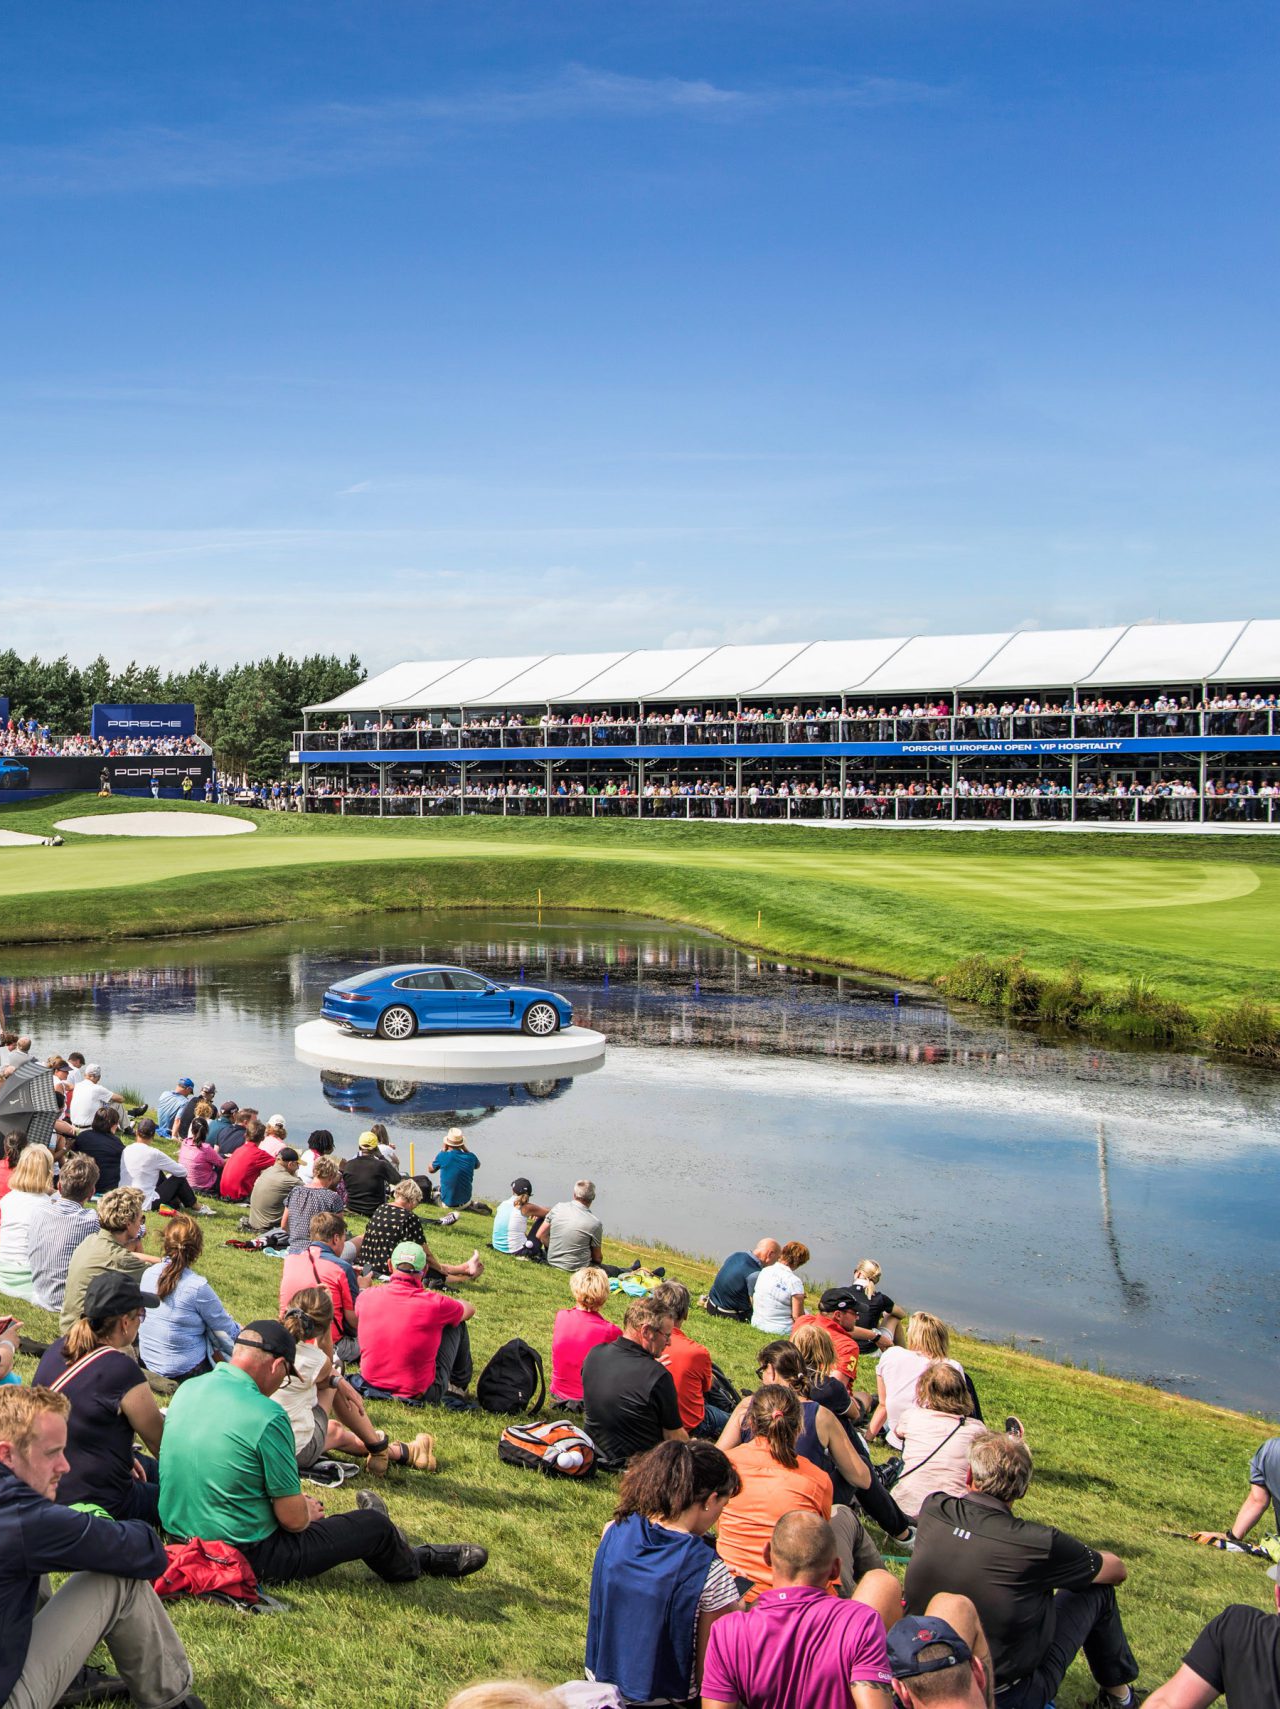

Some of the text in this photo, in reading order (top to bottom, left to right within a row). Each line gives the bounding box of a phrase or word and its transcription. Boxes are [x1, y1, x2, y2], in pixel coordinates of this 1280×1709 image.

[901, 745, 948, 753] PORSCHE
[949, 744, 1002, 752] EUROPEAN
[1004, 743, 1032, 751] OPEN
[1040, 743, 1056, 751] VIP
[1058, 742, 1122, 750] HOSPITALITY
[115, 768, 201, 776] PORSCHE
[846, 1355, 857, 1372] 3
